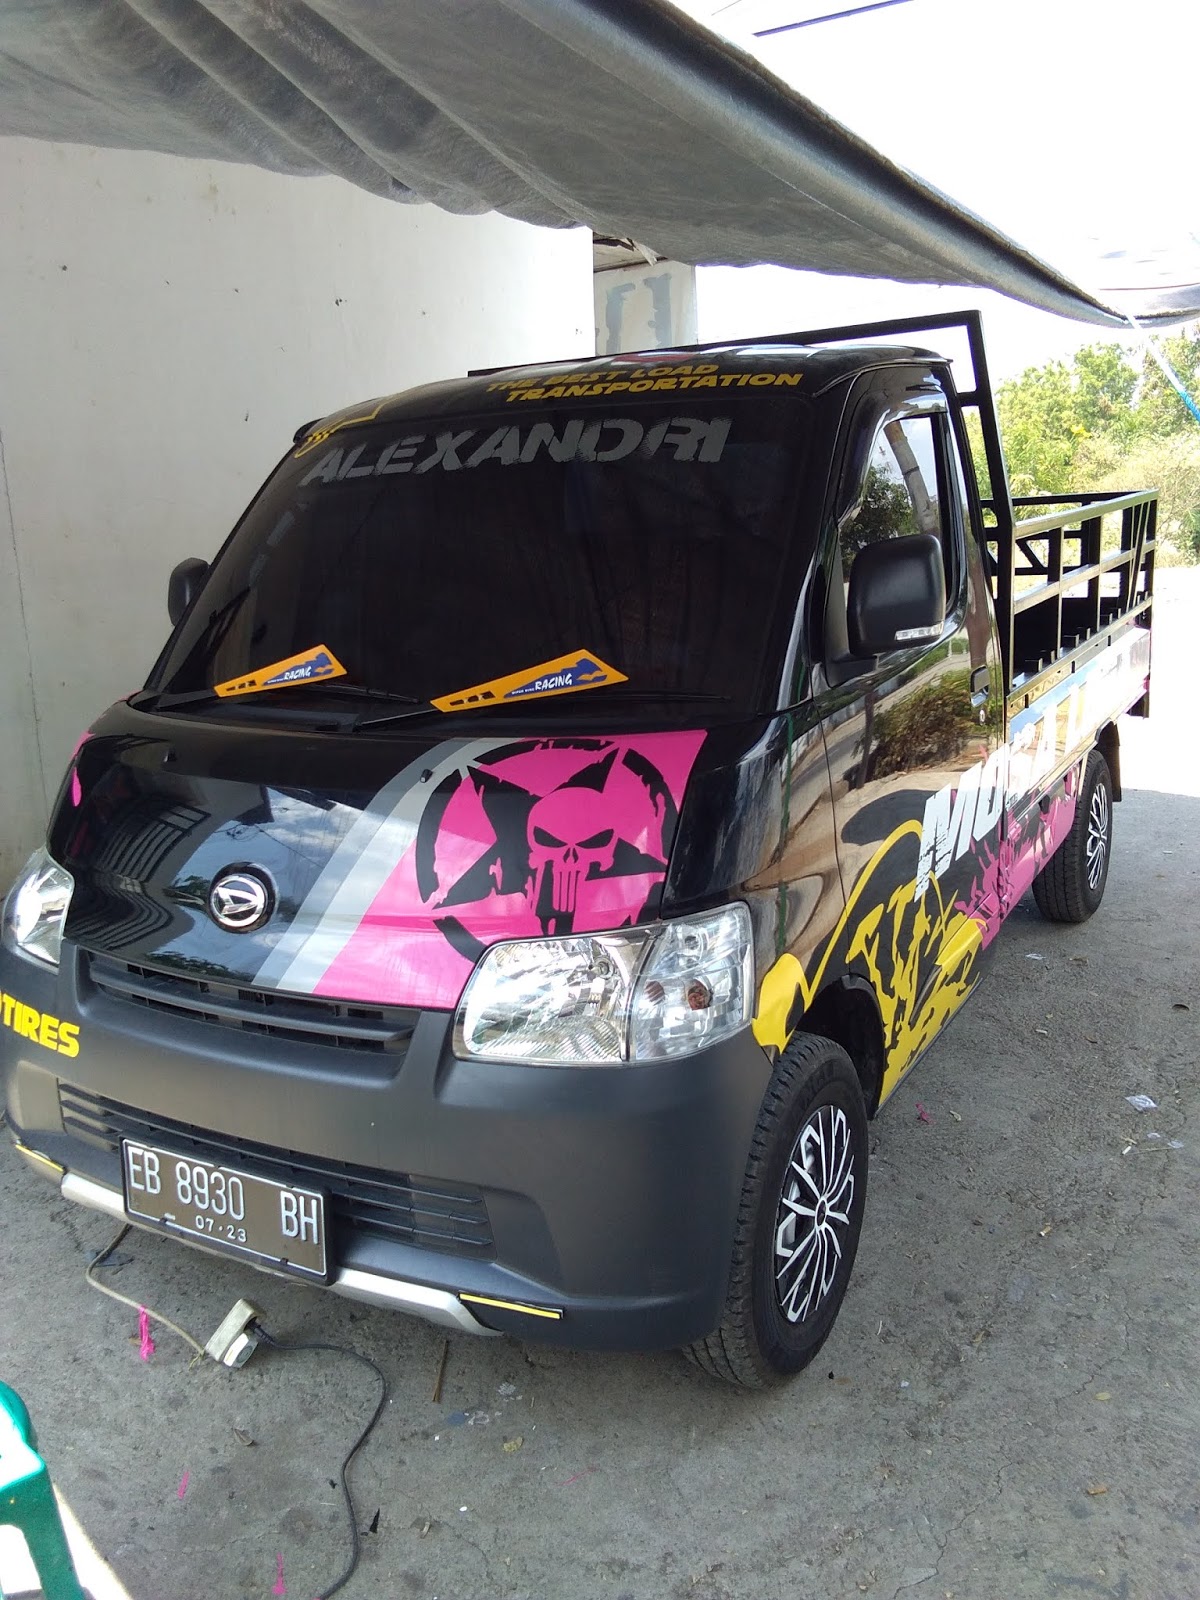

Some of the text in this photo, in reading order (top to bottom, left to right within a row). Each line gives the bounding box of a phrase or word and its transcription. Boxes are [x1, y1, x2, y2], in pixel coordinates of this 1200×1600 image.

[487, 364, 719, 392] THE BEST LOAD
[506, 373, 802, 402] TRANSPORTATION
[298, 417, 734, 486] ALEXANDRI
[284, 666, 311, 680] RACING
[535, 673, 572, 691] RACING
[2, 993, 80, 1058] TIRES
[128, 1146, 319, 1244] EB 8930 BH
